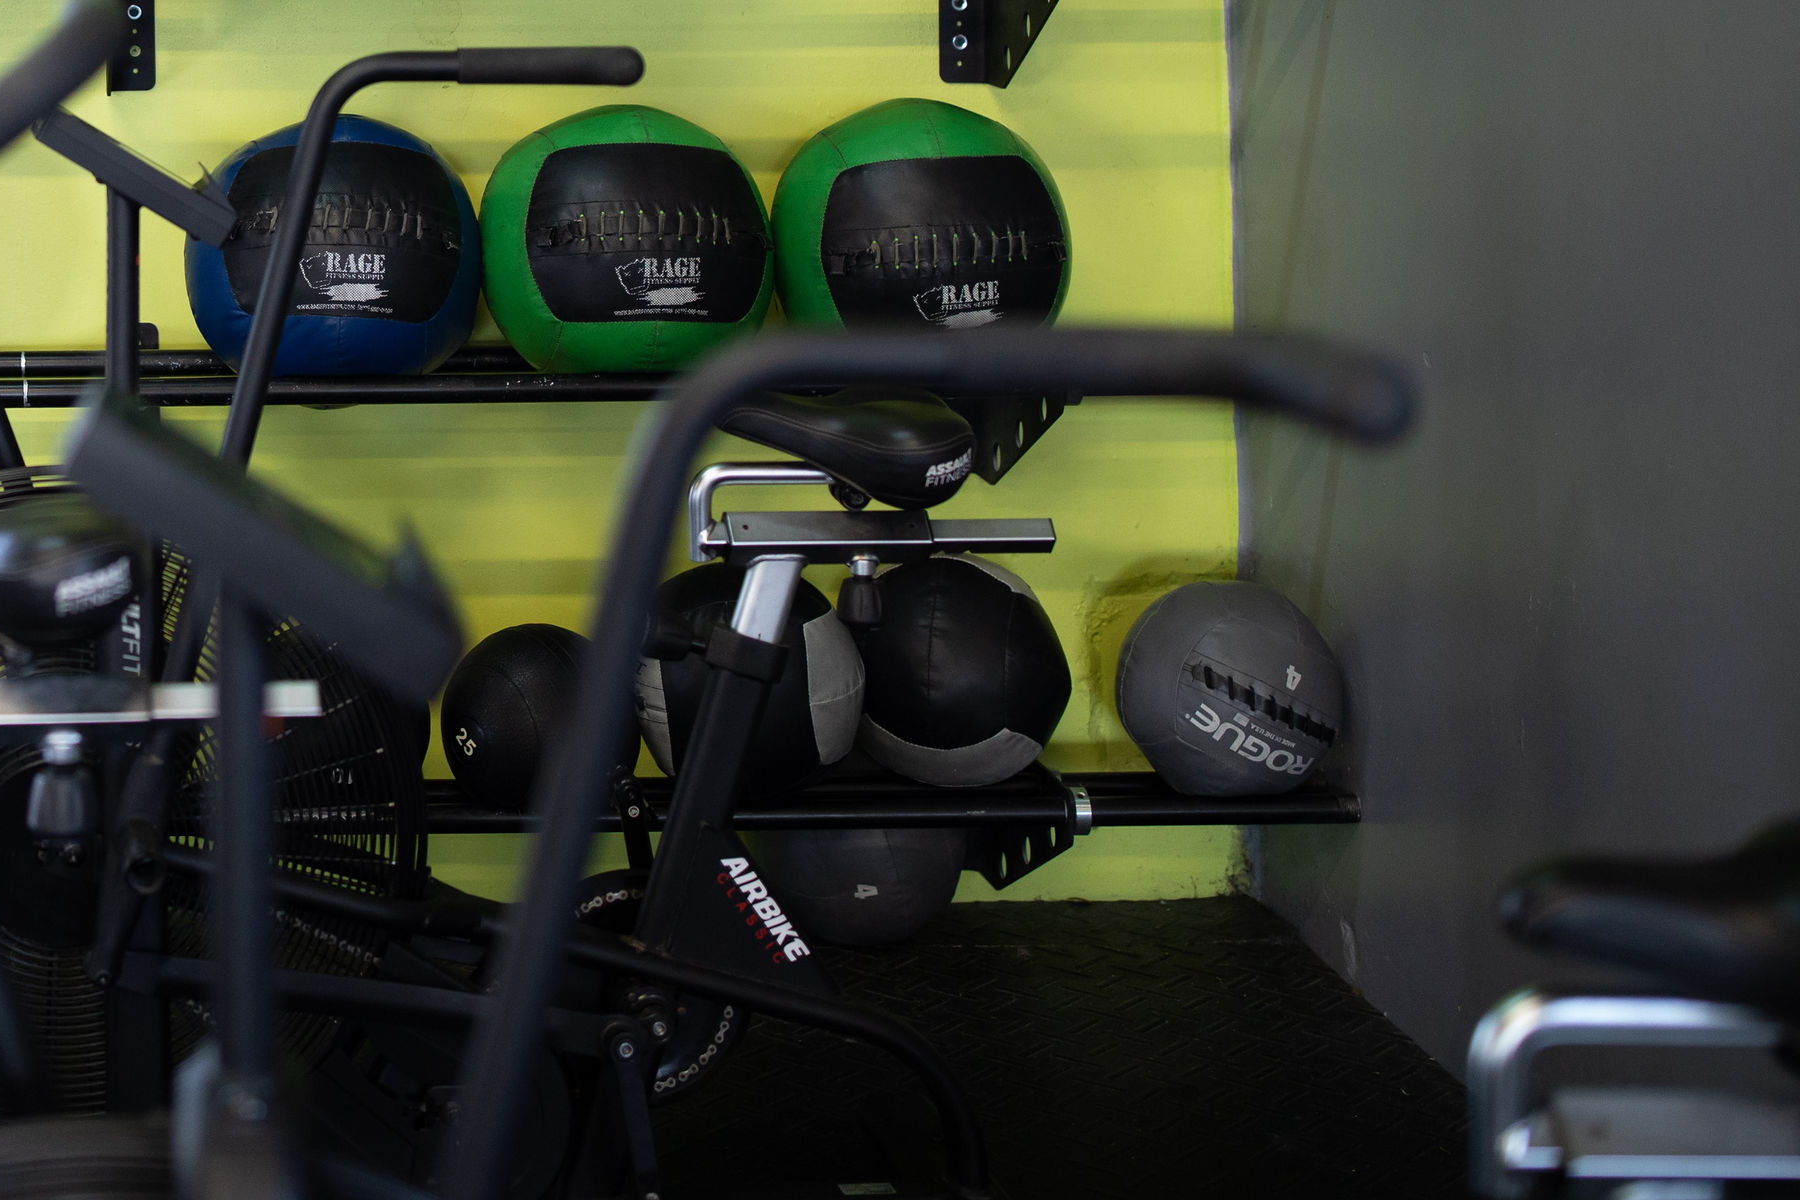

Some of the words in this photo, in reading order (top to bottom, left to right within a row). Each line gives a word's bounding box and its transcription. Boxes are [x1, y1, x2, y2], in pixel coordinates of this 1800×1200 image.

[325, 251, 386, 274] RAGE
[643, 257, 701, 278] RAGE
[941, 280, 1000, 305] RAGE
[1285, 664, 1302, 691] 4
[456, 728, 477, 756] 25
[1189, 703, 1314, 775] ROGUE
[716, 872, 785, 964] CLASSIC
[720, 857, 811, 962] AIRBIKE
